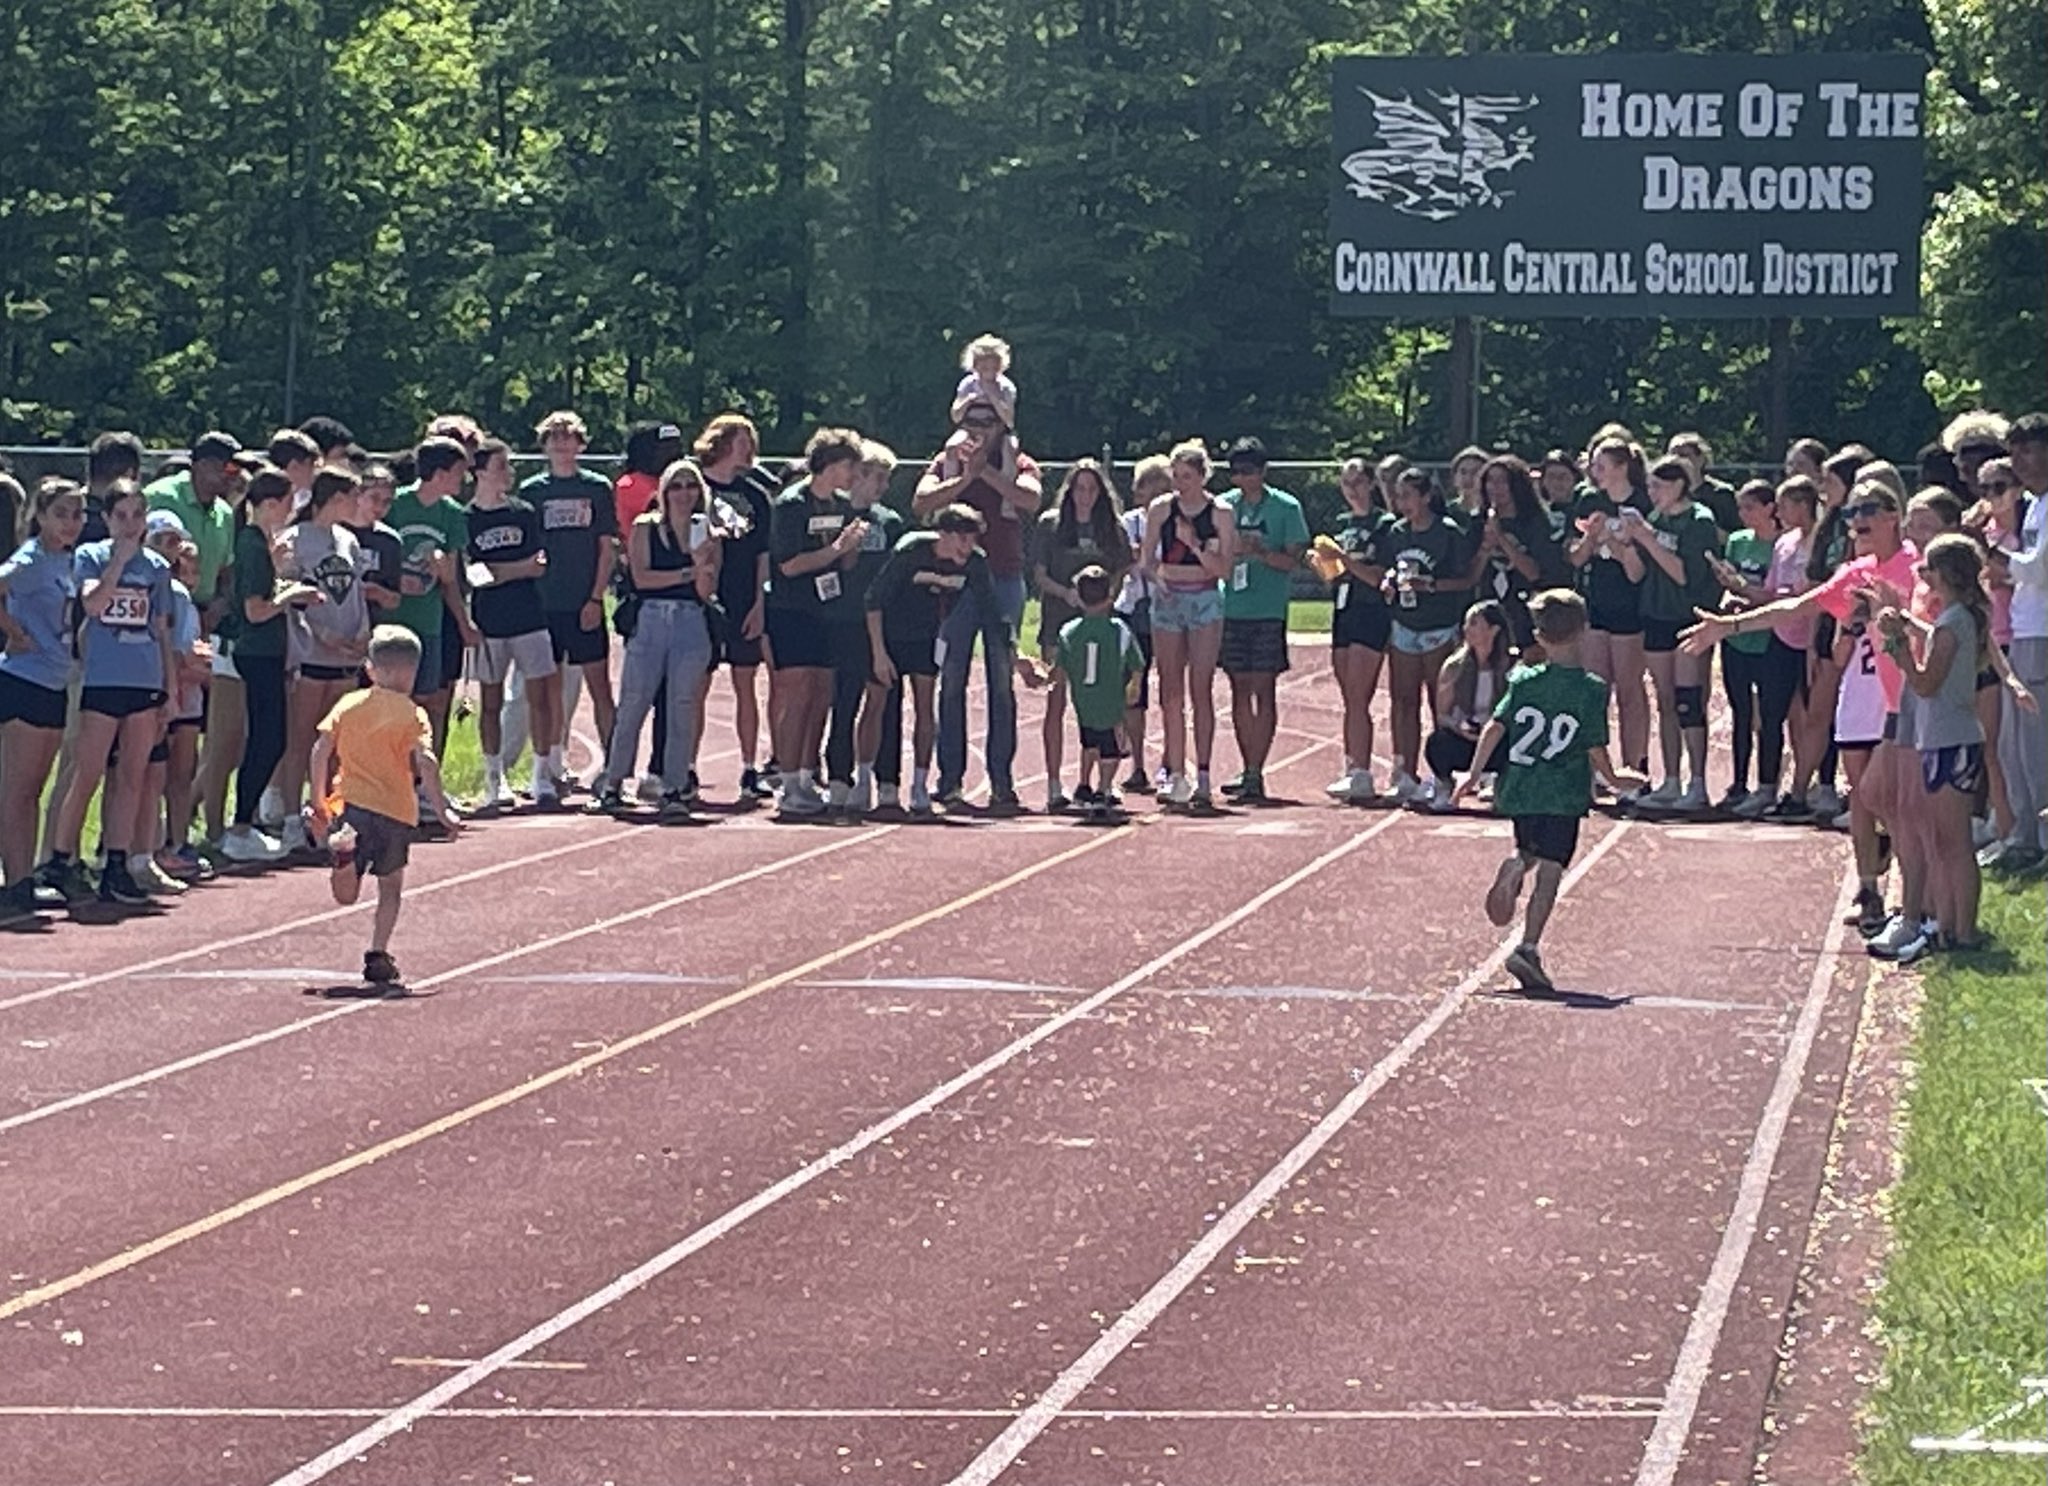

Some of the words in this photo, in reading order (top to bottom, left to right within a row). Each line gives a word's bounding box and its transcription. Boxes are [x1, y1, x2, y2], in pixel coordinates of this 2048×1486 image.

[1581, 82, 1723, 138] HOME
[1737, 82, 1804, 137] OF
[1818, 82, 1920, 137] THE
[1642, 156, 1874, 211] DRAGONS
[1334, 242, 1496, 294] CORNWALL
[1503, 242, 1638, 295] CENTRAL
[1645, 242, 1754, 295] SCHOOL
[1762, 243, 1900, 296] DISTRICT
[1083, 641, 1099, 686] 1
[1508, 705, 1580, 767] 29
